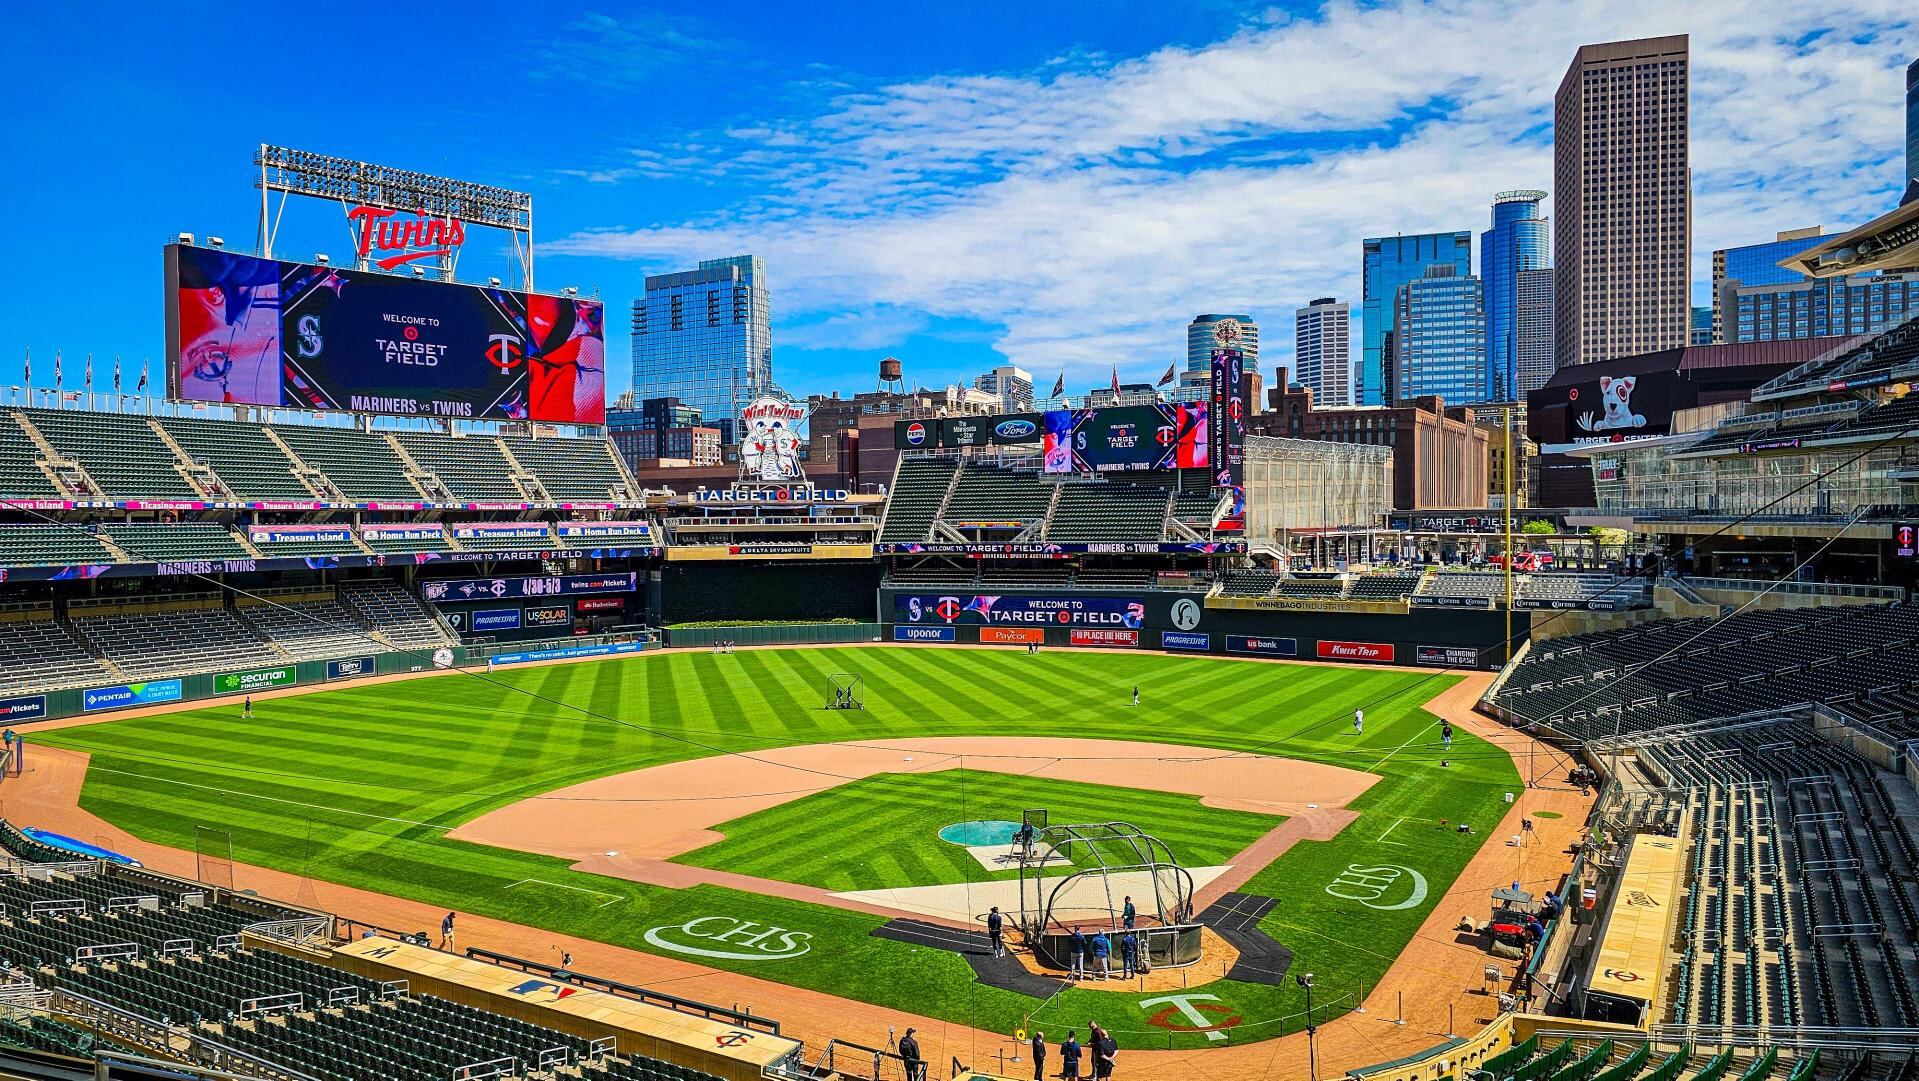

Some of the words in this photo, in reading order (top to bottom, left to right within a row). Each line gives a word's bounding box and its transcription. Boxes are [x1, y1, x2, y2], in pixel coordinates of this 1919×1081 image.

[348, 205, 465, 257] Twins
[1870, 275, 1903, 283] LOFTON
[383, 313, 426, 326] WELCOME
[428, 318, 440, 327] TO
[375, 339, 448, 356] TARGET
[385, 351, 439, 367] FIELD
[351, 395, 418, 414] MARINERS
[432, 400, 472, 417] TWINS
[742, 404, 768, 419] Win!
[768, 403, 805, 420] Twins!
[953, 425, 977, 433] Minnesota
[1003, 423, 1028, 435] Ford
[908, 430, 924, 438] PEPSI
[1107, 435, 1139, 443] TARGET
[1216, 437, 1222, 445] TO
[1573, 436, 1611, 445] TARGET
[1096, 462, 1125, 471] MARINERS
[1131, 462, 1150, 470] TWINS
[696, 489, 774, 501] TARGET
[793, 489, 849, 501] FIELD
[0, 502, 34, 510] easure
[36, 501, 64, 510] Island
[262, 502, 294, 511] Treasure
[294, 502, 314, 510] Island
[1421, 518, 1464, 527] TARGET
[380, 531, 404, 540] Home
[405, 531, 421, 539] Run
[421, 530, 441, 539] Deck
[479, 530, 515, 538] Treasure
[516, 529, 541, 537] Island
[585, 528, 607, 536] Home
[608, 528, 622, 536] Run
[623, 528, 642, 536] Deck
[274, 533, 315, 543] Treasure
[317, 532, 344, 542] Island
[965, 544, 1004, 552] TARGET
[1013, 544, 1043, 552] FIELD
[1087, 543, 1126, 553] MARINERS
[1134, 543, 1159, 553] TWINS
[451, 553, 483, 561] WELCOME
[496, 551, 541, 560] TARGET
[552, 550, 583, 559] FIELD
[157, 561, 212, 576] MARINERS
[223, 559, 257, 573] TWINS
[522, 577, 561, 596] 4/30-5/3
[571, 579, 627, 589] twins.com/tickets
[1028, 600, 1070, 609] WELCOME
[1071, 601, 1083, 609] TO
[1411, 596, 1433, 604] Corona
[1437, 597, 1460, 605] Corona
[1465, 598, 1488, 606] Corona
[1516, 599, 1540, 607] Corona
[1551, 600, 1576, 609] Corona
[1587, 601, 1613, 609] Corona
[540, 609, 567, 620] SOLAR
[991, 610, 1056, 622] TARGET
[1073, 612, 1122, 623] FIELD
[475, 615, 517, 625] PROGRESSIVE
[907, 629, 942, 639] uponor
[995, 631, 1027, 641] Paycor
[1083, 631, 1104, 640] PLACE
[1115, 632, 1133, 641] HERE
[1165, 636, 1207, 646] PROGRESSIVE
[1257, 641, 1277, 649] bank
[528, 652, 545, 660] There's
[1446, 649, 1476, 658] CHANGING
[1458, 657, 1475, 665] GAME
[240, 669, 286, 683] securian
[240, 681, 273, 690] FINANCIAL
[98, 692, 131, 702] PENTAIR
[1325, 862, 1402, 901] CHS
[681, 916, 814, 953] CHS
